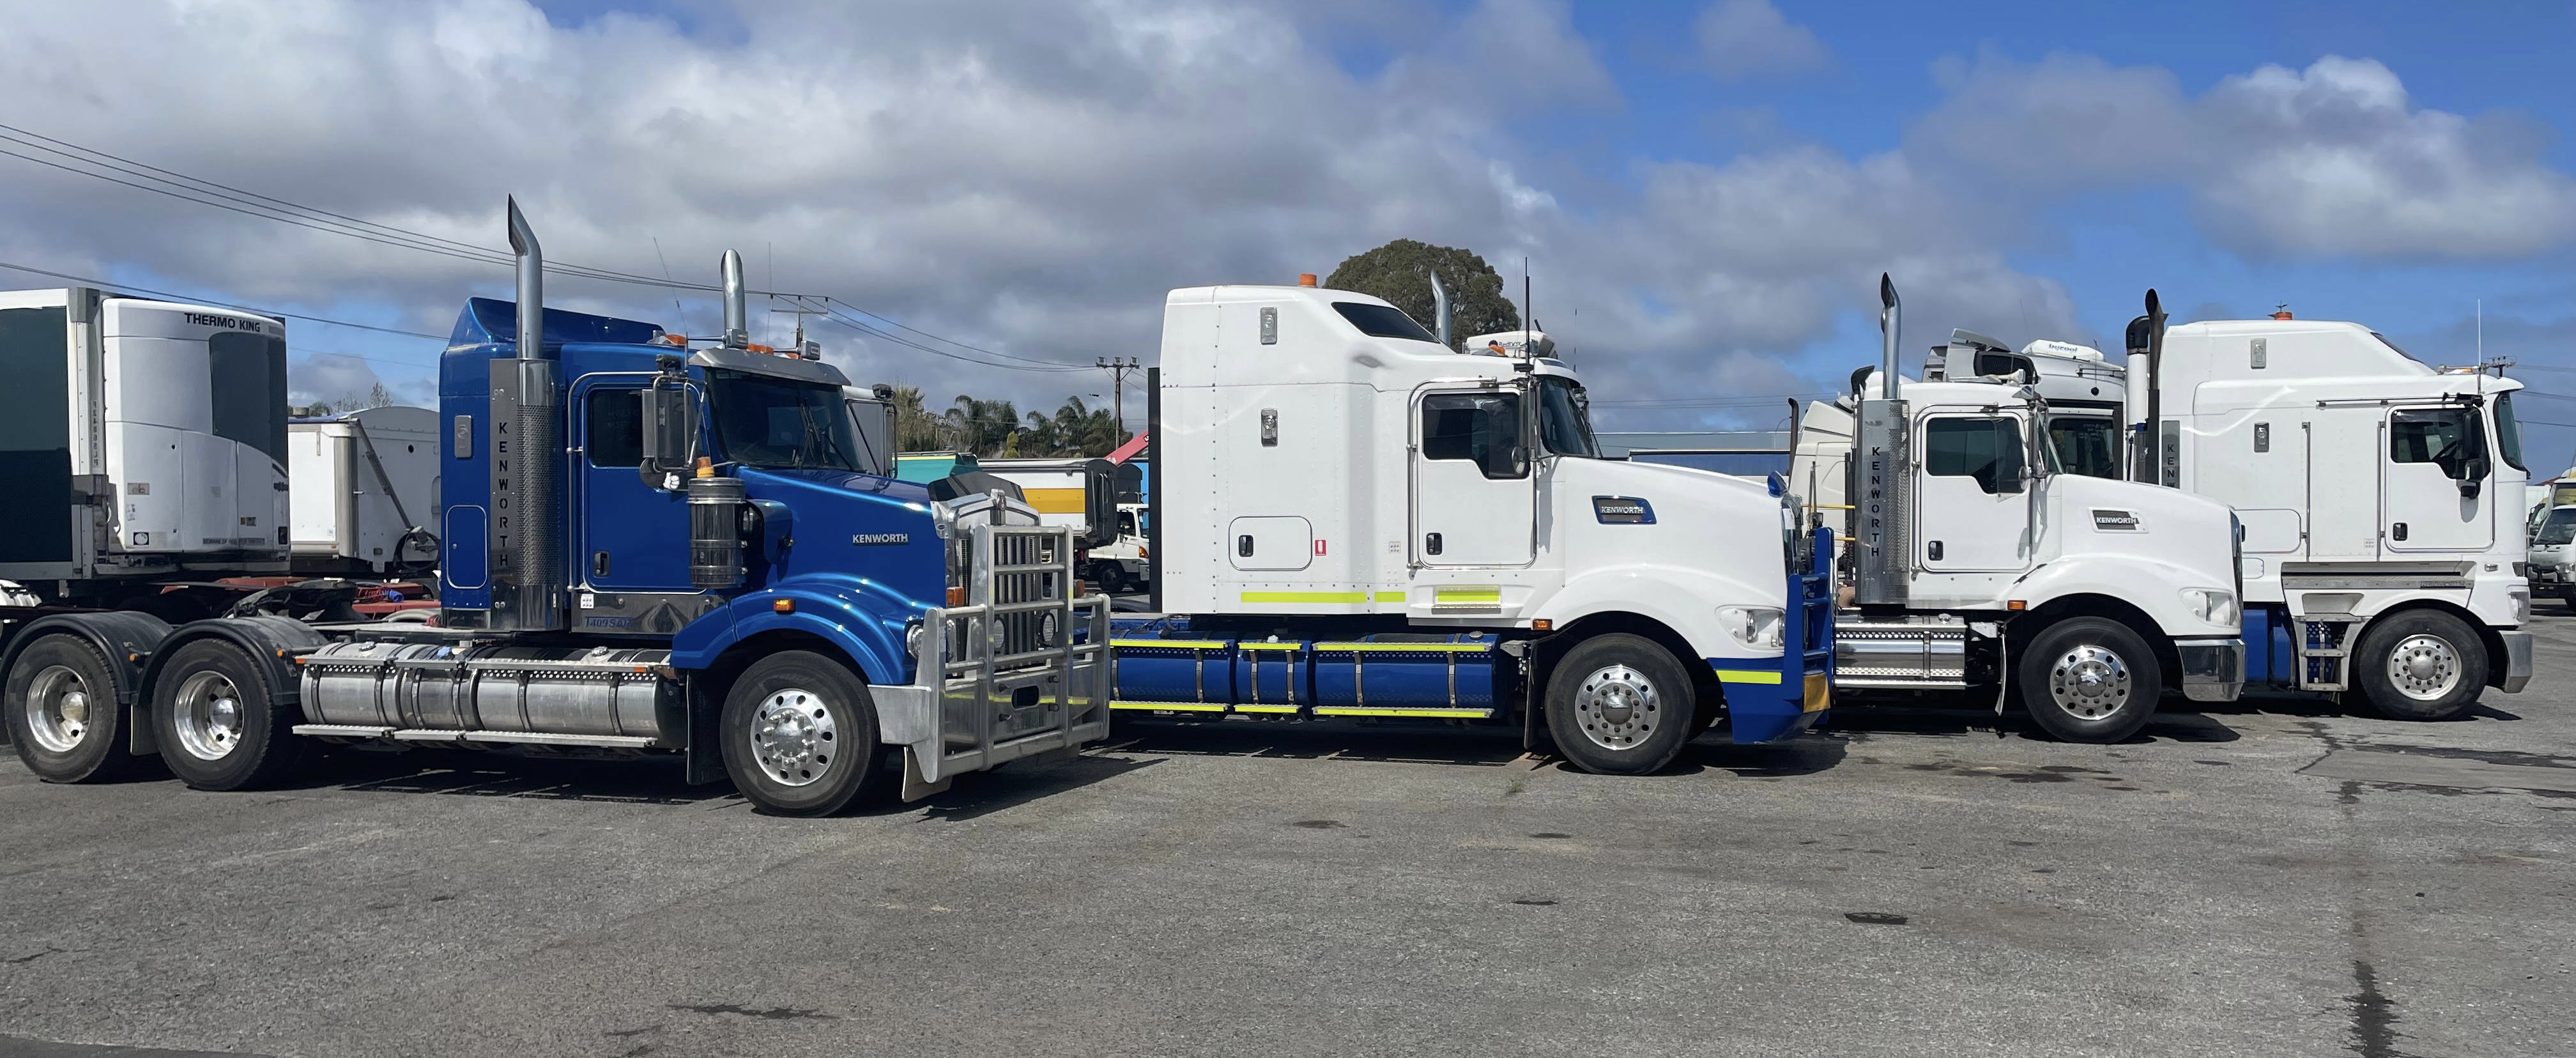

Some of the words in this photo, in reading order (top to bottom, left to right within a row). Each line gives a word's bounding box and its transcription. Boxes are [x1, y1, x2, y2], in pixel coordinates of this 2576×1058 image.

[185, 313, 236, 328] THERMO
[240, 320, 261, 332] KING
[498, 422, 509, 566] KENWORTH
[1871, 447, 1880, 556] KENWORTH
[852, 533, 908, 544] KENWORTH
